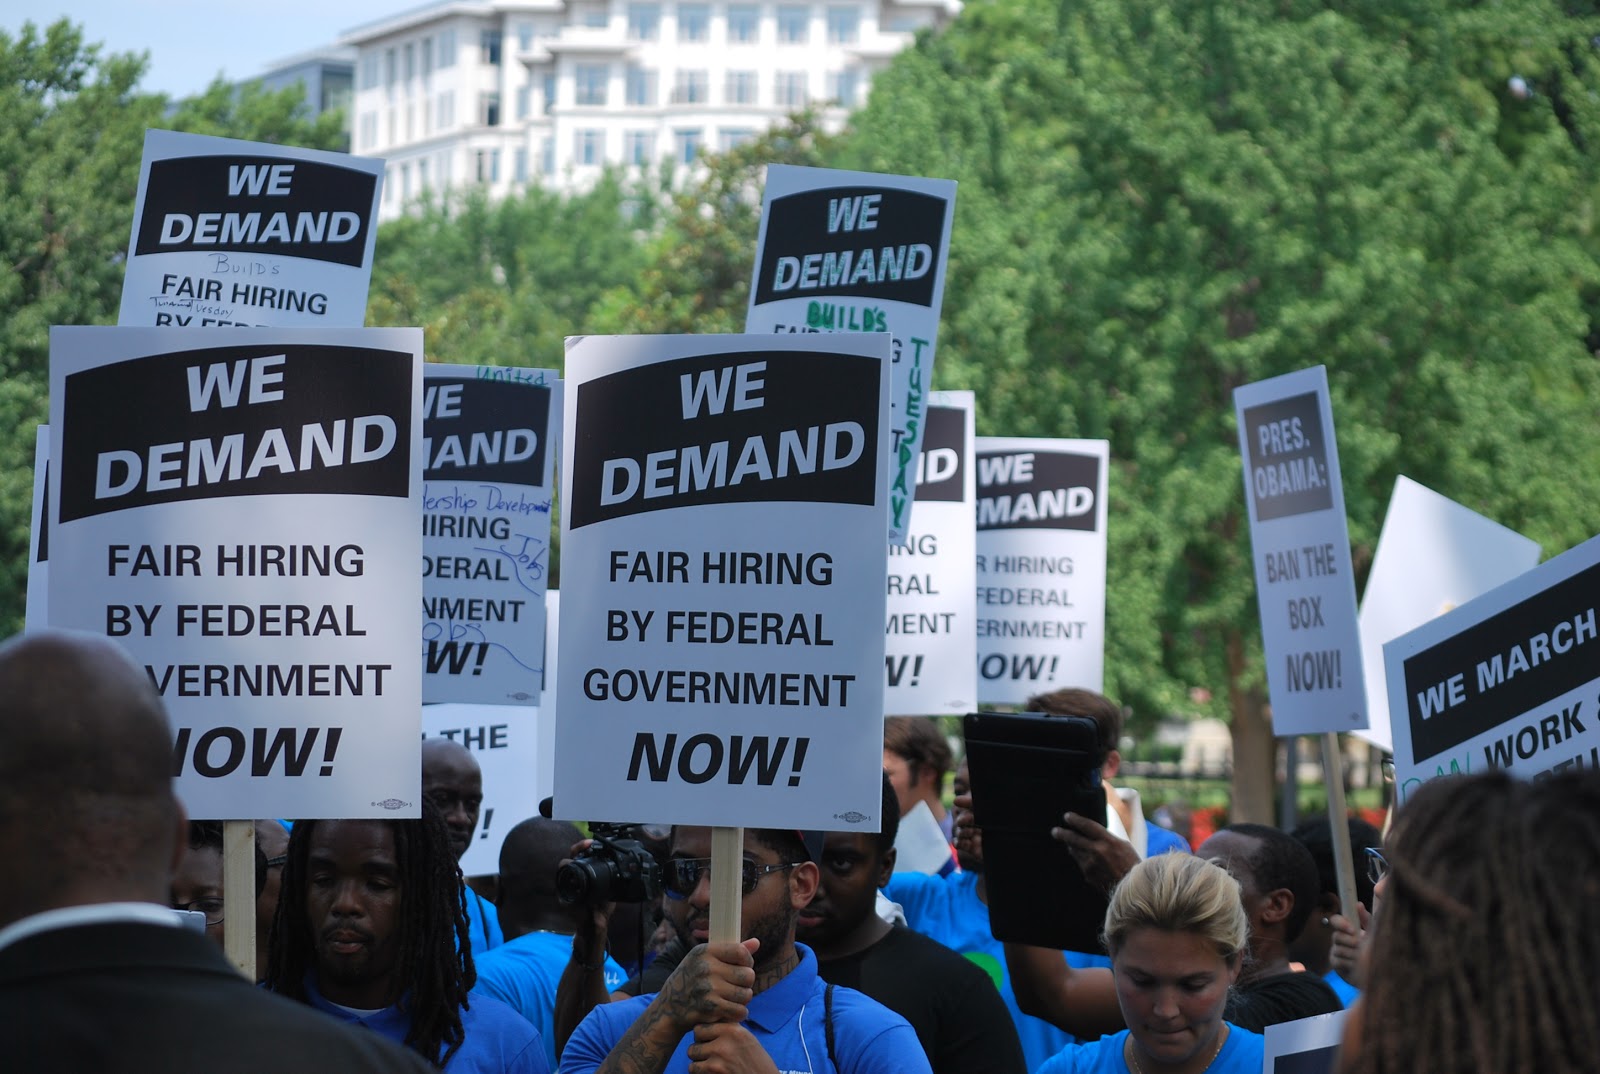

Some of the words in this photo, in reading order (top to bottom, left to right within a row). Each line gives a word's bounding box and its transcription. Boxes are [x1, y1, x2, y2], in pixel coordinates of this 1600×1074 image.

[228, 165, 295, 196] WE
[159, 211, 360, 245] DEMAND
[828, 194, 882, 233] WE
[772, 243, 933, 292] DEMAND
[161, 273, 223, 302] FAIR
[231, 282, 328, 315] HIRING
[187, 354, 286, 412] WE
[680, 361, 767, 420] WE
[892, 337, 929, 528] TUESDAY
[1258, 416, 1311, 456] PRES.
[95, 414, 397, 500] DEMAND
[601, 421, 866, 506] DEMAND
[979, 453, 1036, 485] WE
[1255, 456, 1328, 499] OBAMA:
[976, 486, 1095, 525] MAND
[108, 545, 202, 576] FAIR
[217, 544, 364, 577] HIRING
[610, 551, 689, 583] FAIR
[702, 552, 833, 585] HIRING
[994, 555, 1074, 575] HIRING
[1265, 548, 1301, 584] BAN
[1303, 543, 1338, 577] THE
[106, 605, 162, 636] BY
[177, 605, 367, 636] FEDERAL
[607, 610, 655, 642] BY
[667, 611, 834, 646] FEDERAL
[1288, 596, 1325, 631] BOX
[976, 652, 1059, 681] OW!
[1286, 650, 1343, 693] NOW!
[1417, 673, 1467, 720] WE
[1476, 608, 1598, 693] MARCH
[583, 668, 856, 707] GOVERNMENT
[1484, 701, 1587, 769] WORK
[626, 732, 811, 787] NOW!
